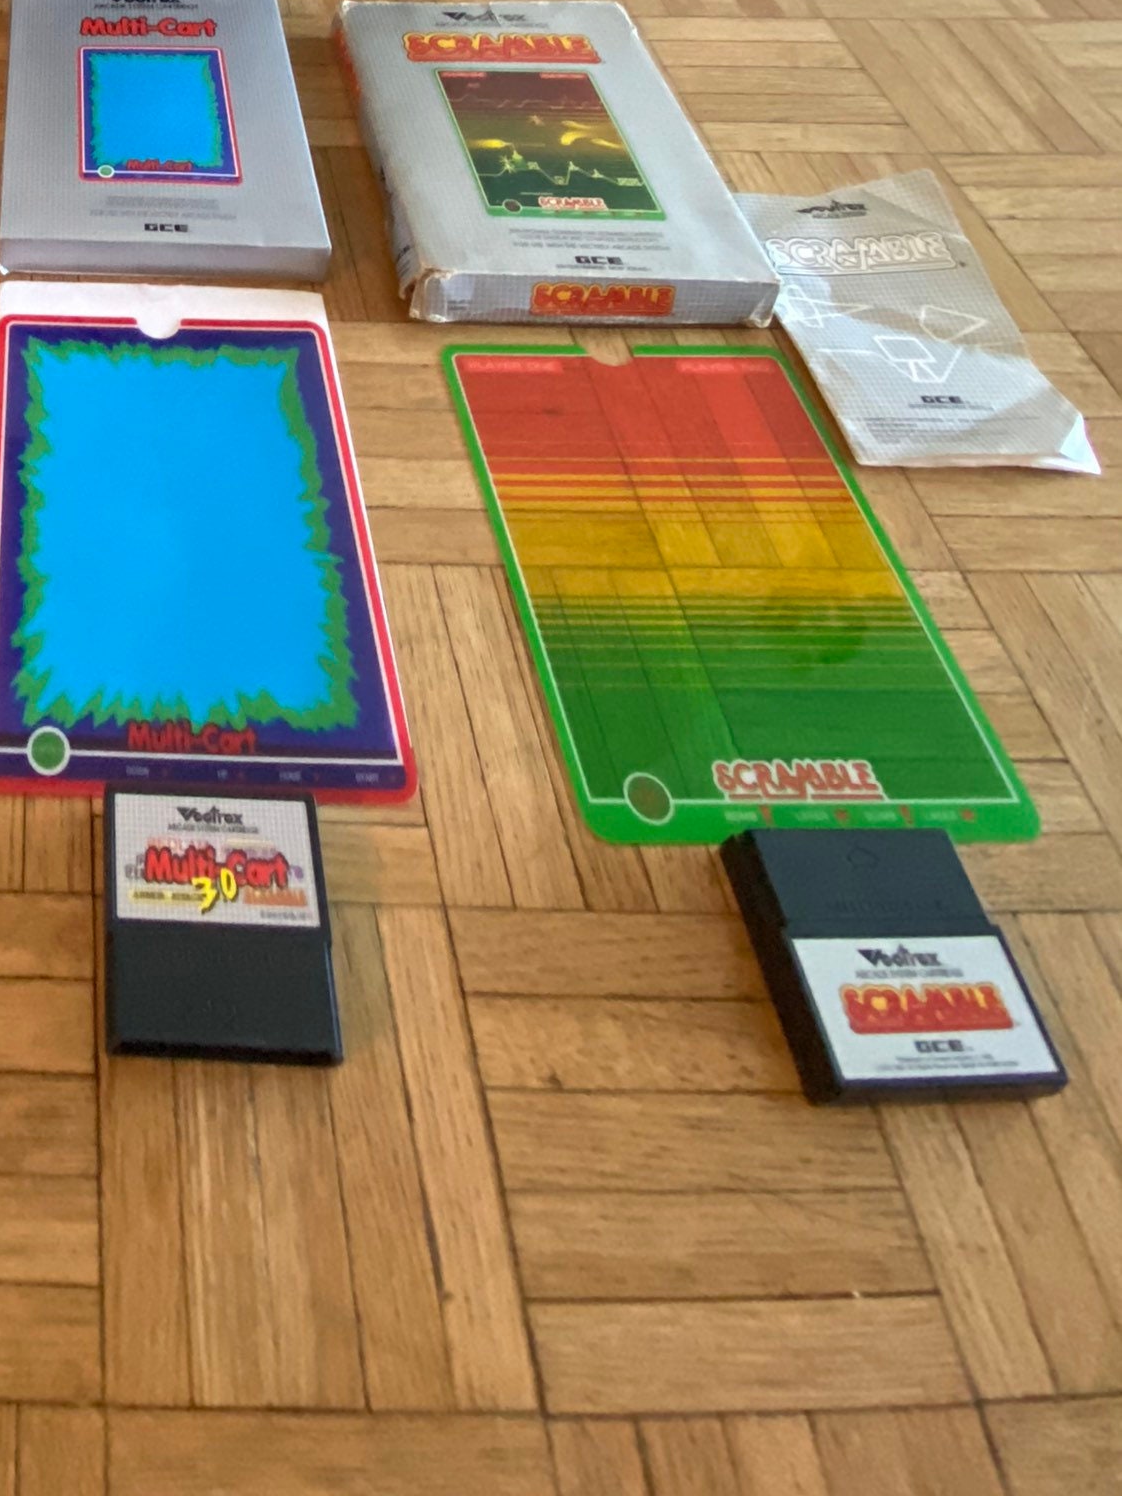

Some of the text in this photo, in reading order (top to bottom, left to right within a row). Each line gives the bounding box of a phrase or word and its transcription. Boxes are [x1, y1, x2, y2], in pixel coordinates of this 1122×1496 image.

[79, 16, 218, 37] Multi-Cart
[402, 31, 602, 63] SCRAMBLE
[765, 231, 958, 276] SCRAMBLE
[127, 718, 257, 756] Multi-Cart
[712, 759, 888, 801] SCRAMBLE
[176, 805, 244, 825] Vectrex
[144, 844, 290, 888] Multi-Cart
